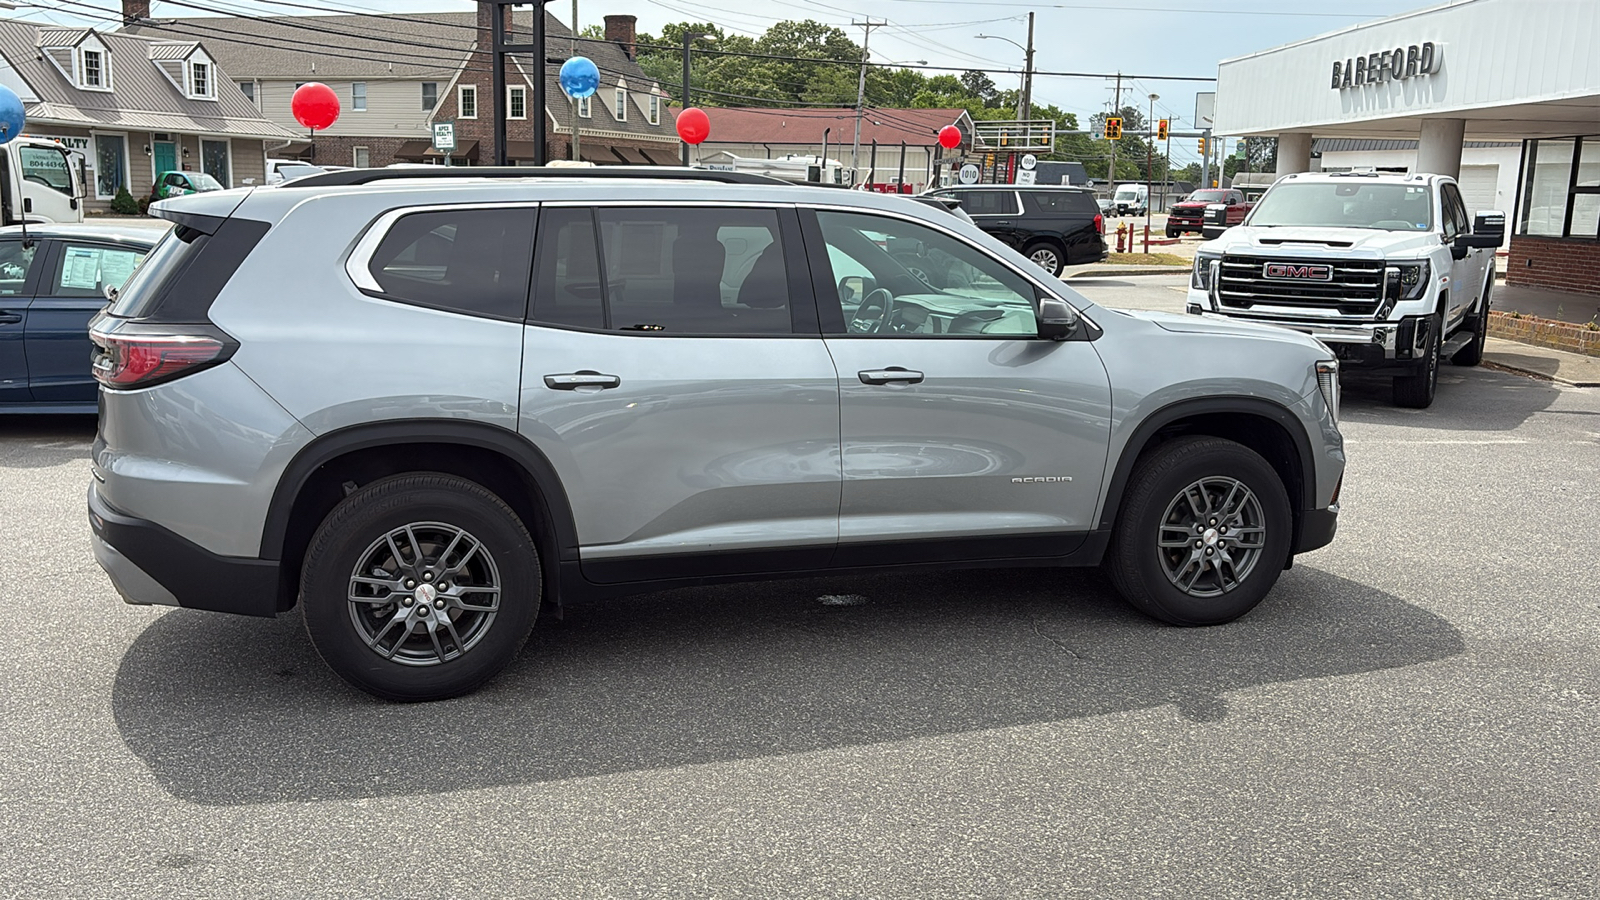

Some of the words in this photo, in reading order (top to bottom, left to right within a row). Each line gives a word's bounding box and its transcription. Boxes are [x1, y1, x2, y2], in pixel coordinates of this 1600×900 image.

[1331, 41, 1439, 89] BAREFORD
[47, 136, 88, 148] ALTY
[961, 169, 977, 179] 1010
[1268, 265, 1328, 279] GMC
